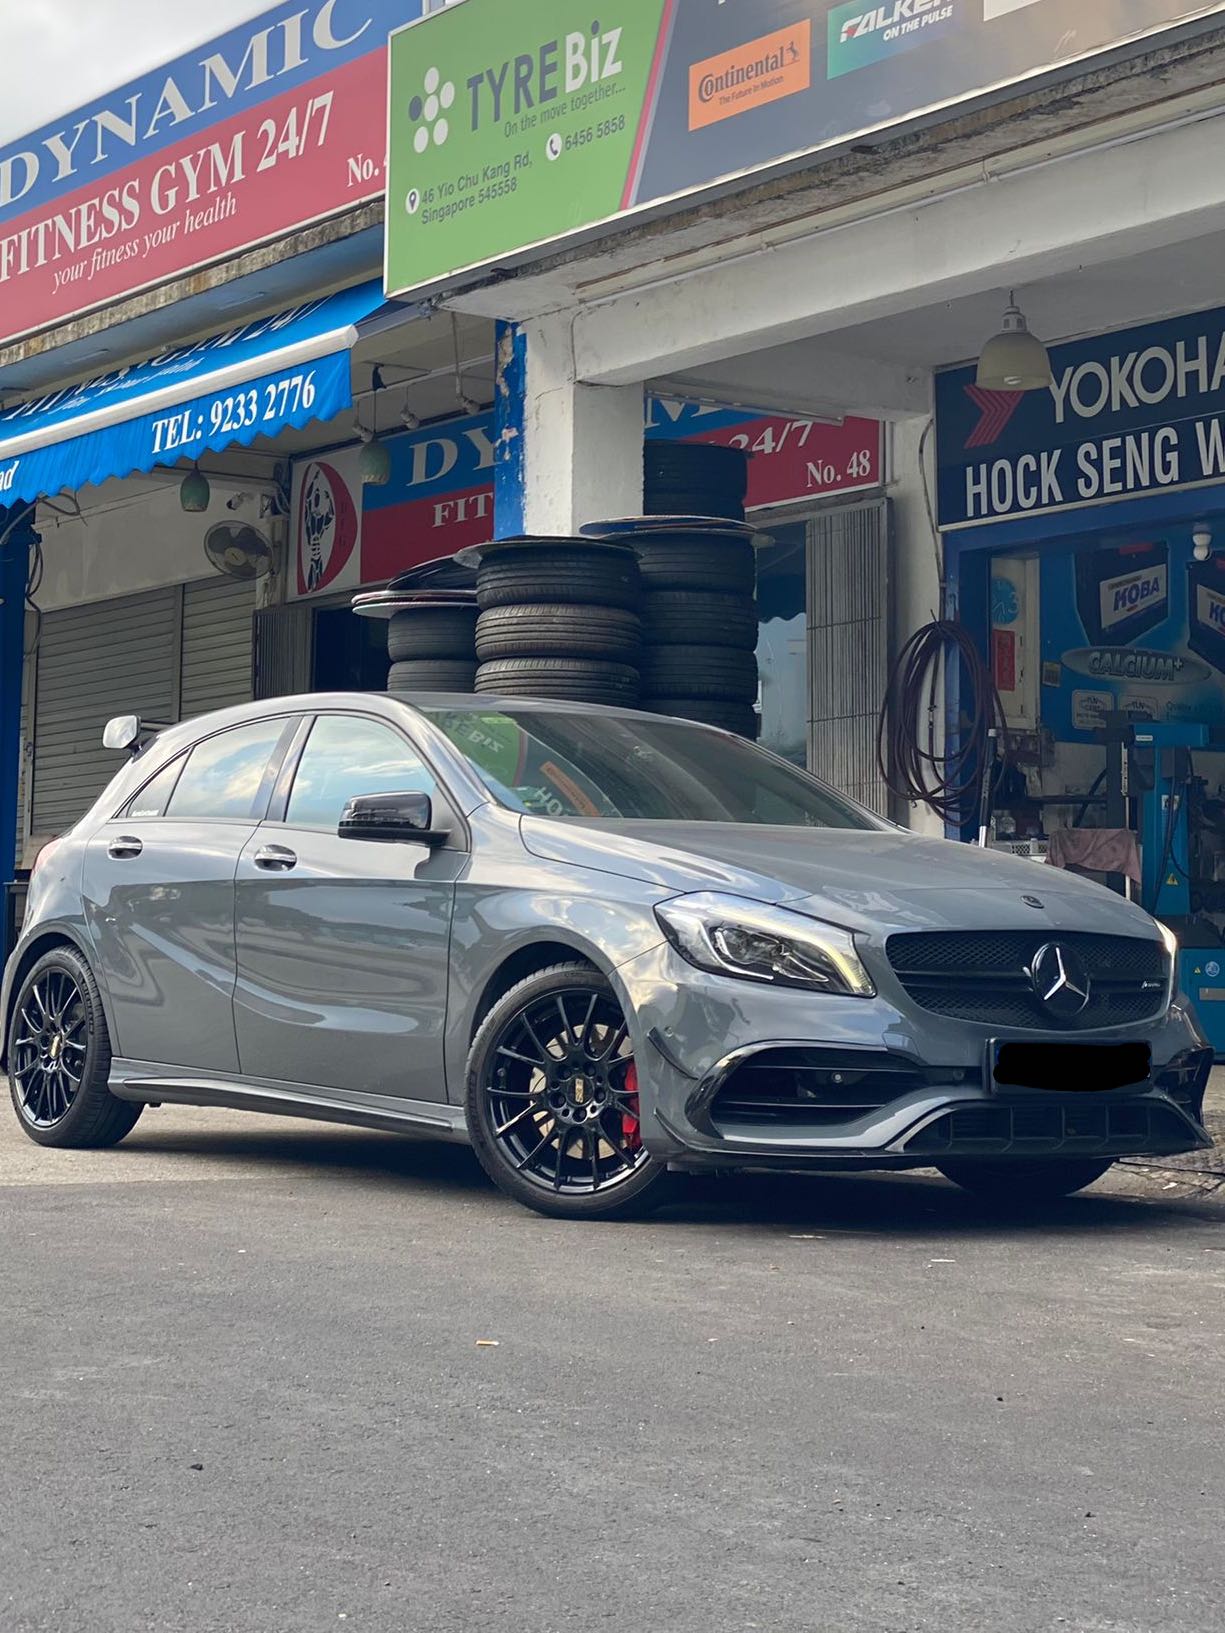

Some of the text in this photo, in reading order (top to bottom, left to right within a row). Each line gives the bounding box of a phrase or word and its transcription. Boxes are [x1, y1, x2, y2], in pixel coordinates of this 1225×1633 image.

[840, 0, 951, 43] FALKE
[883, 5, 953, 41] ON THE PULSE
[698, 46, 784, 103] Continental
[719, 96, 731, 105] The
[731, 87, 752, 102] Future
[761, 75, 784, 90] Motion
[0, 0, 372, 204] DYNAMIC
[504, 120, 518, 138] On
[520, 114, 537, 131] the
[540, 104, 567, 123] move
[565, 115, 625, 151] 6456 5858
[0, 90, 334, 282] FITNESS GYM 24/7
[347, 154, 379, 186] No.
[421, 188, 434, 204] 46
[437, 182, 454, 201] Yio
[457, 173, 479, 192] Chu
[482, 161, 510, 182] Kang
[421, 176, 517, 225] Singapore 545558
[52, 193, 237, 294] your fitness your health
[151, 411, 203, 454] TEL:
[208, 388, 257, 436] 9233
[263, 370, 316, 421] 2776
[805, 450, 871, 487] No. 48
[966, 449, 1063, 517] HOCK
[1077, 426, 1179, 498] SENG
[432, 492, 493, 528] FIT
